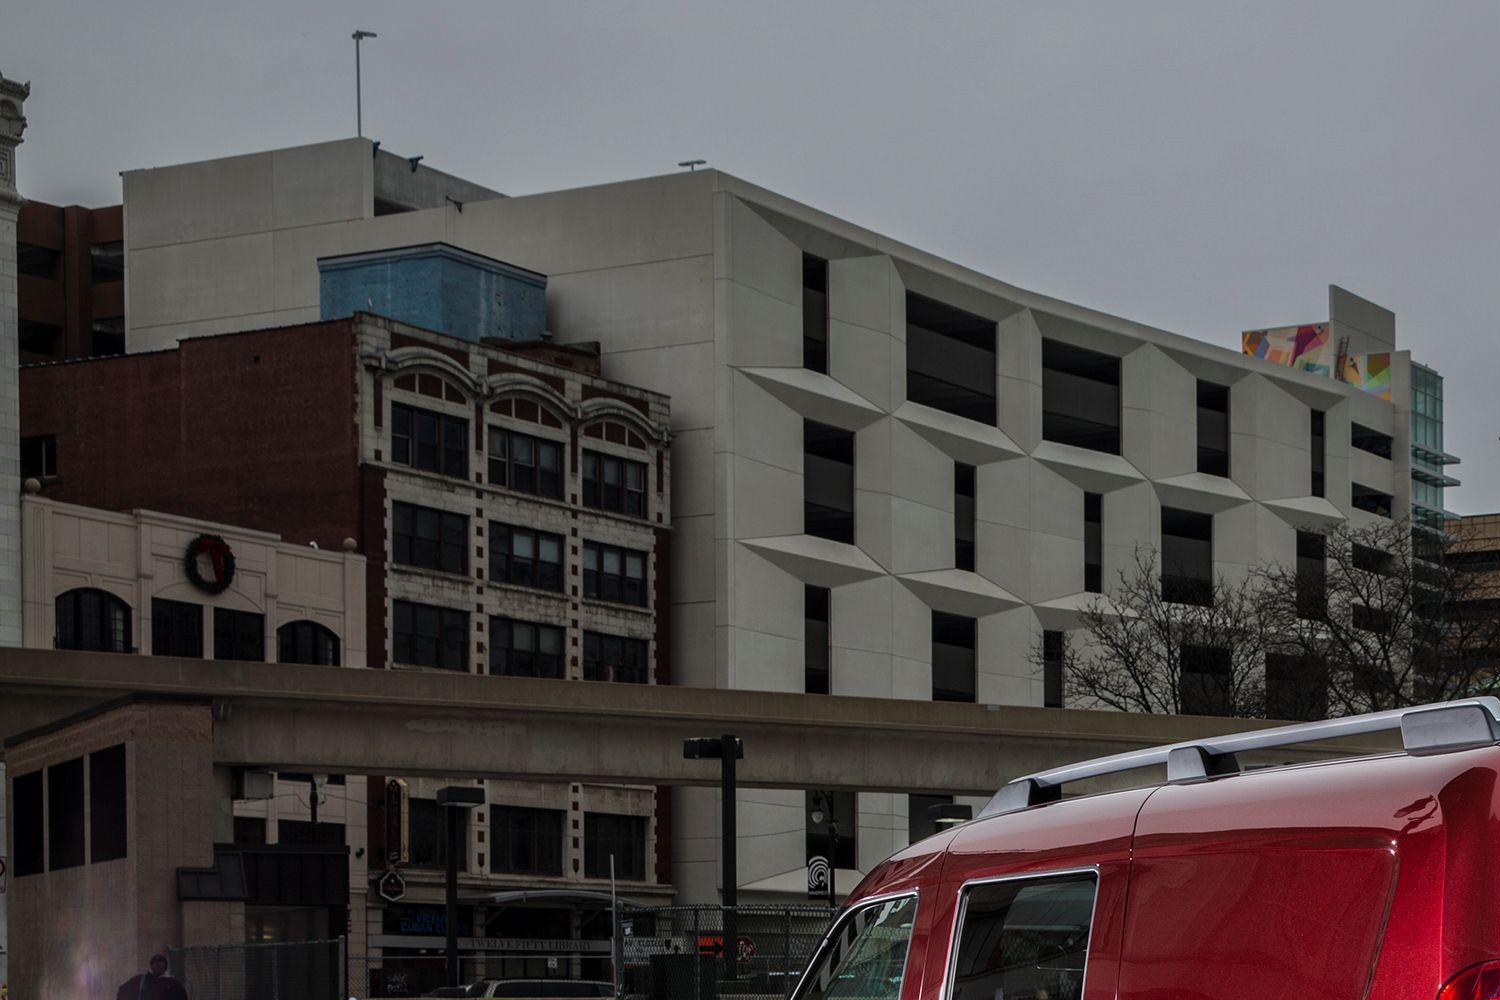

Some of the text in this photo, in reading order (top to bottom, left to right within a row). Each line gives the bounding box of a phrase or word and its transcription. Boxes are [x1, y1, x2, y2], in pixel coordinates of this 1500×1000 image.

[471, 938, 592, 950] TWELVE FIFTY LIBRARY
